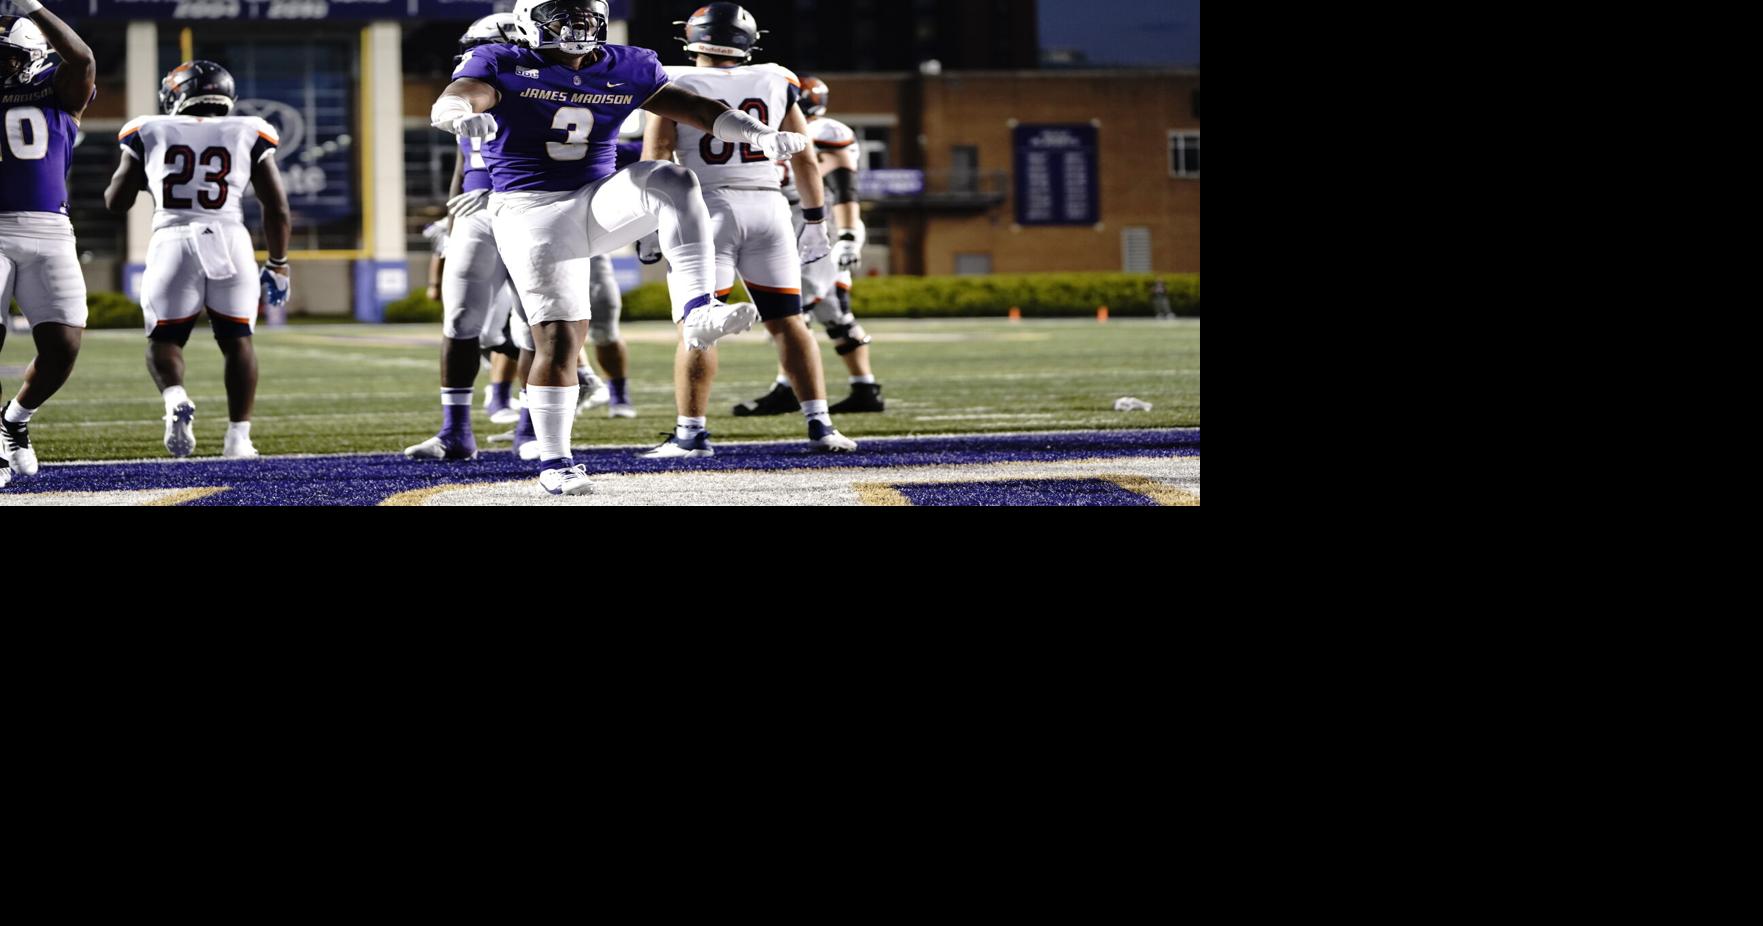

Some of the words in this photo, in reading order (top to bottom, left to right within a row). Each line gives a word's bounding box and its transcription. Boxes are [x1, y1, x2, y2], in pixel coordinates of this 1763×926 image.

[519, 87, 567, 102] JAMES
[570, 92, 634, 105] MADISON
[0, 105, 49, 161] 0
[544, 105, 595, 161] 3
[162, 144, 232, 210] 23
